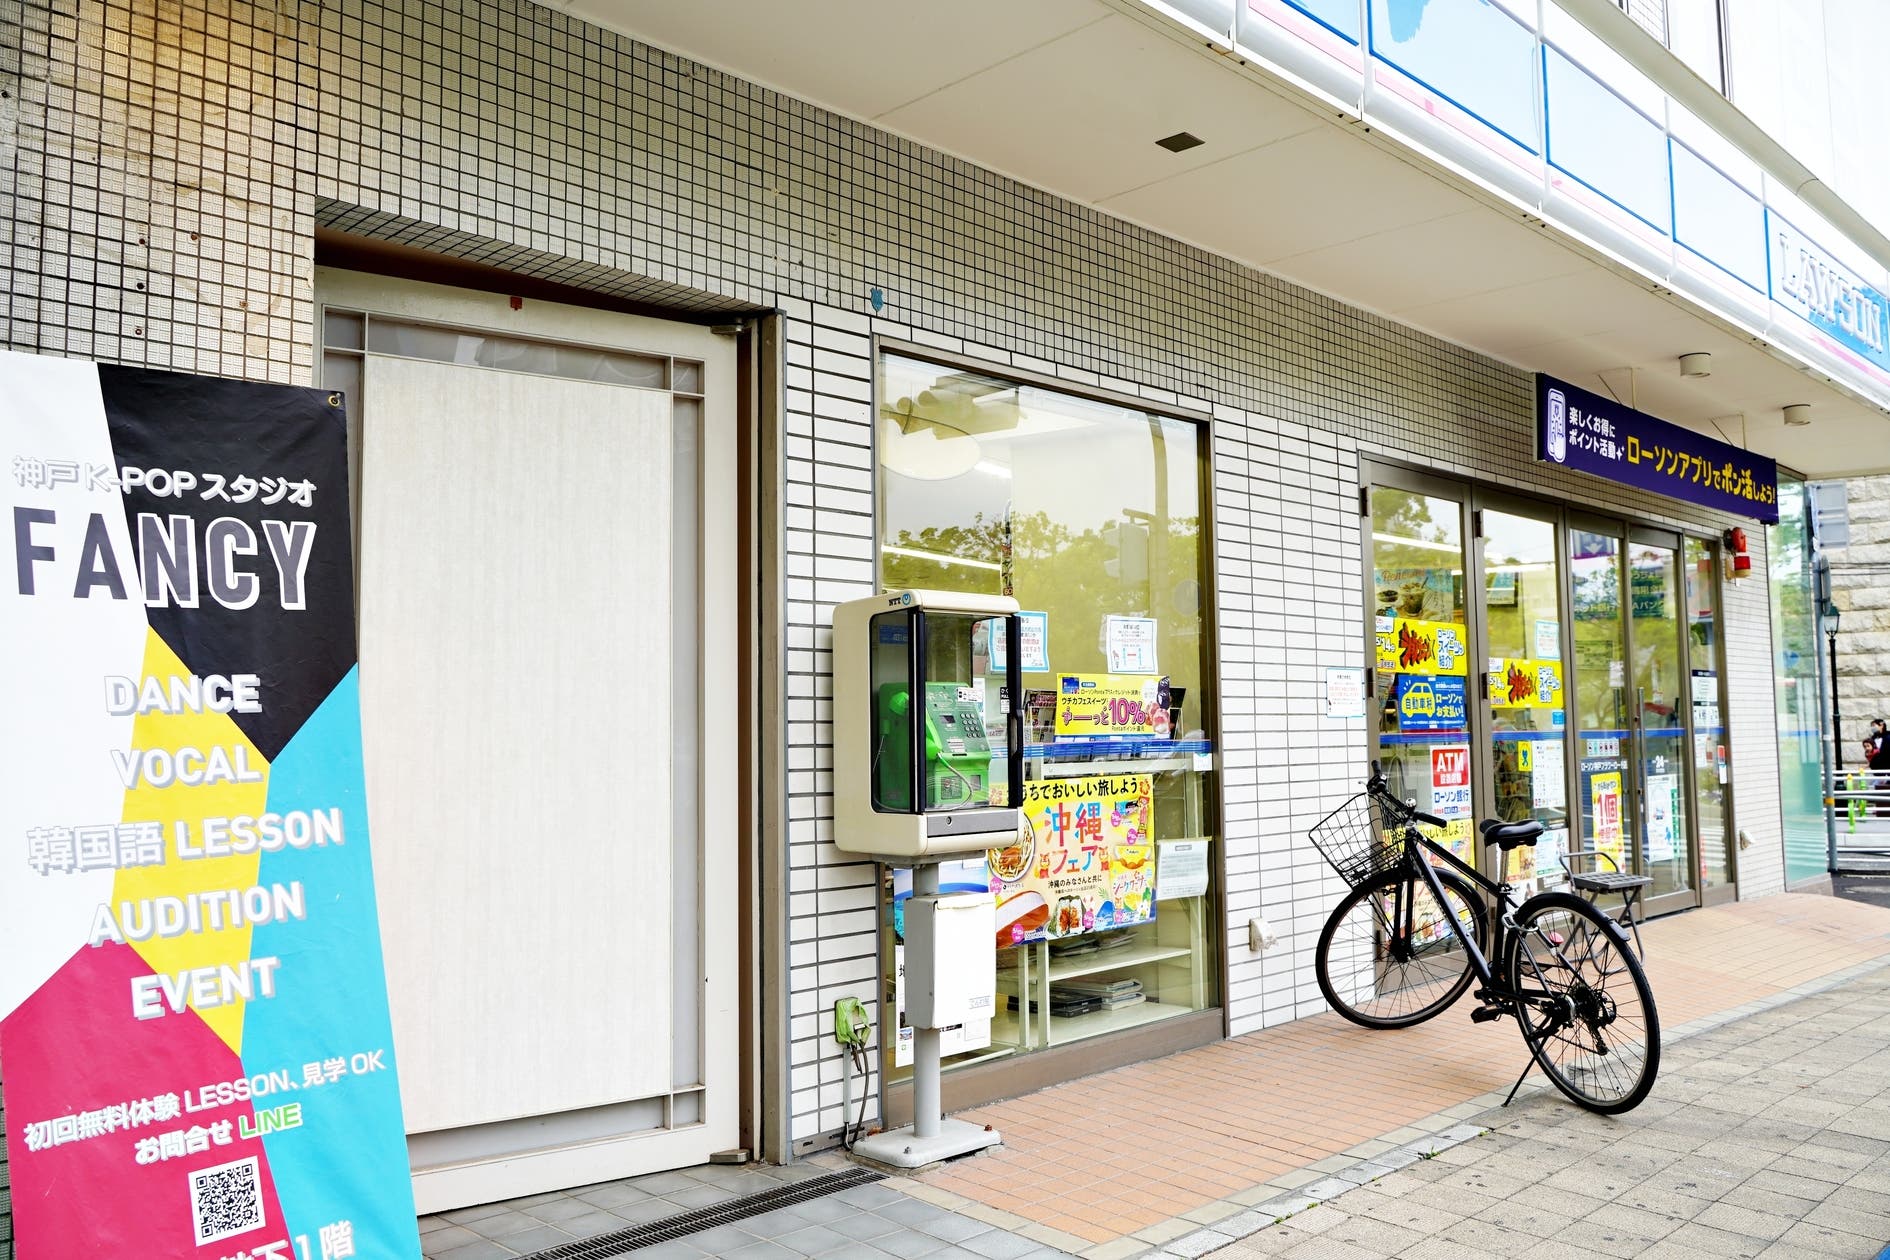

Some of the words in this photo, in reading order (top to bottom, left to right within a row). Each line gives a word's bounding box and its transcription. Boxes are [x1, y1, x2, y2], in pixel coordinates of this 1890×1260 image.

[1780, 233, 1883, 353] LAWSON
[1569, 406, 1616, 438] 楽しくお得に
[1568, 429, 1616, 461] ポイント活動
[12, 456, 79, 489] 神戸
[87, 463, 197, 499] K-POP
[200, 472, 317, 508] スタジオ
[1627, 435, 1776, 505] ローソンアプリでポン活しよう!
[13, 506, 318, 611] FANCY
[889, 597, 901, 606] NTT
[104, 674, 263, 716] DANCE
[1061, 697, 1108, 705] ウチカフェスイーツ
[111, 746, 264, 788] VOCAL
[1437, 752, 1464, 772] ATM
[1022, 777, 1138, 801] うちでおいしい旅しよう
[26, 820, 166, 876] 韓国語
[174, 807, 345, 862] LESSON
[1044, 802, 1104, 847] 沖縄
[1052, 845, 1099, 875] フェア
[88, 881, 305, 949] AUDITION
[131, 956, 282, 1021] EVENT
[23, 1089, 182, 1153] 初回無料体験
[351, 1048, 387, 1076] OK
[134, 1119, 234, 1167] お問合せ
[239, 1102, 303, 1140] LINE
